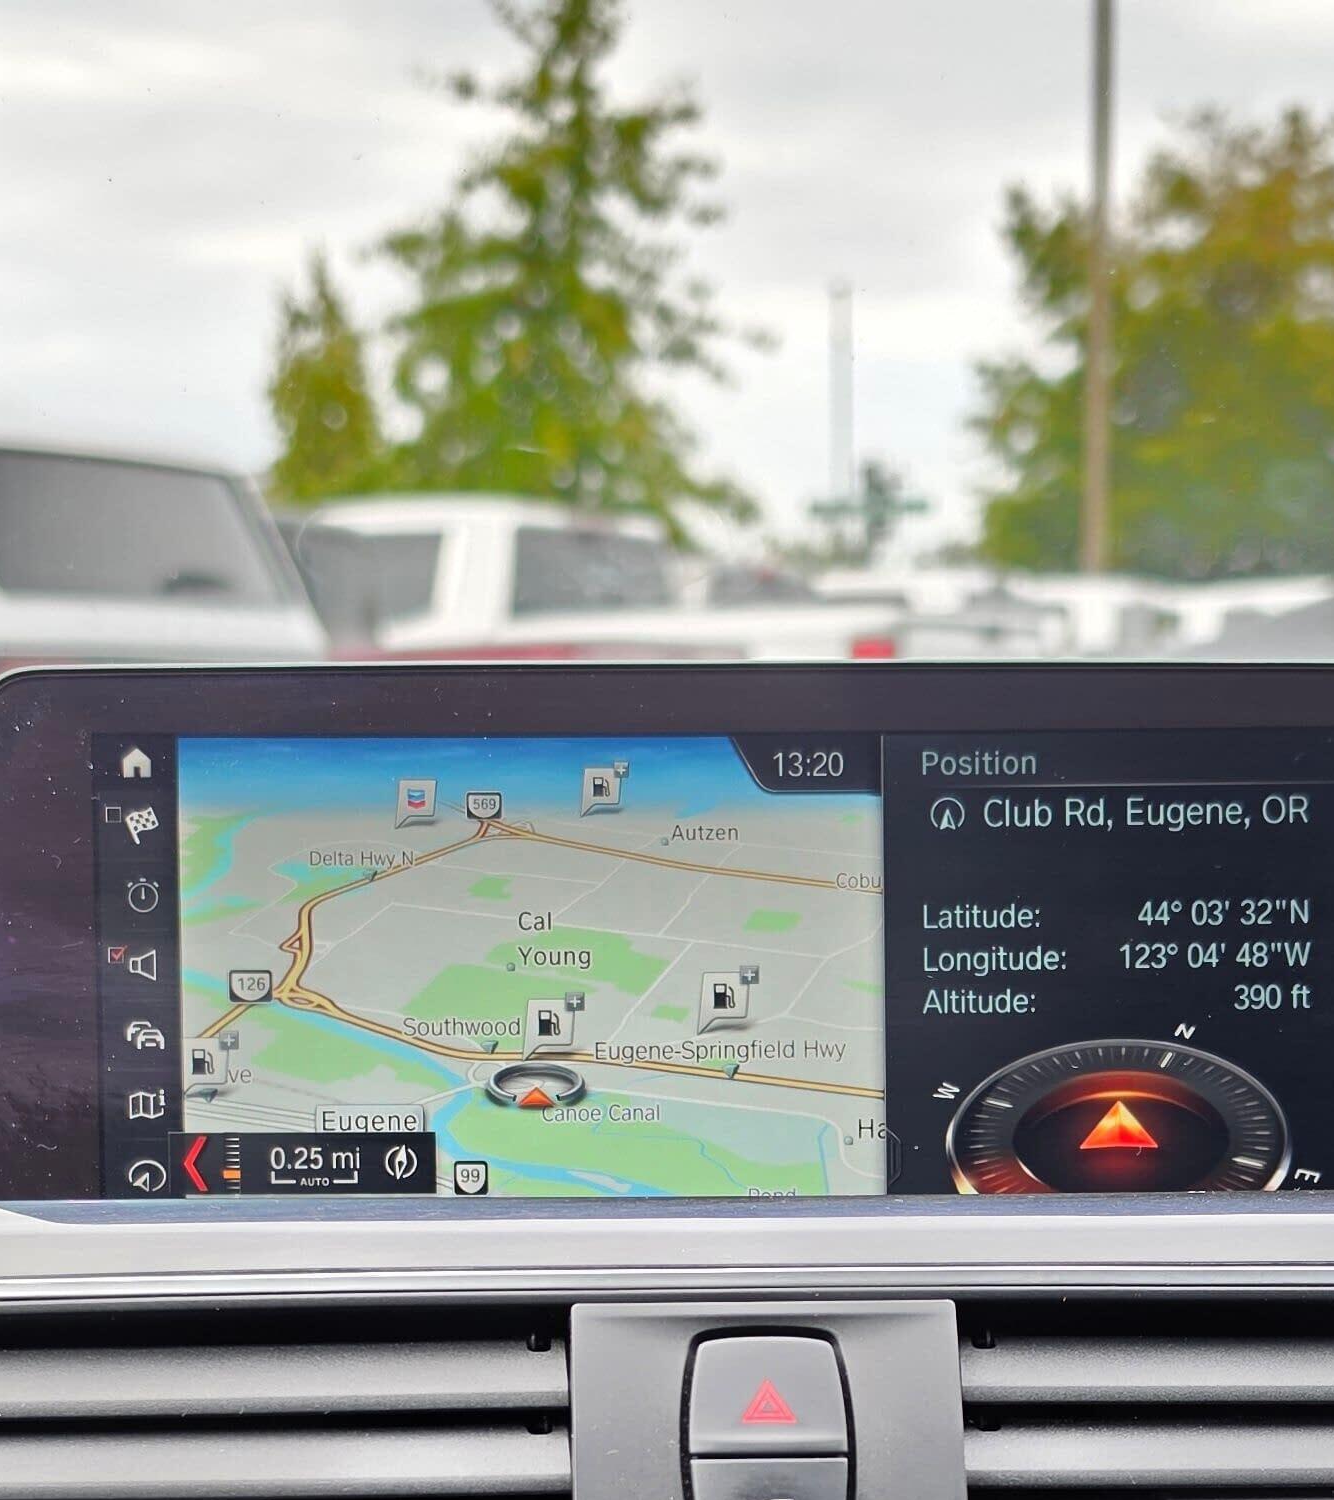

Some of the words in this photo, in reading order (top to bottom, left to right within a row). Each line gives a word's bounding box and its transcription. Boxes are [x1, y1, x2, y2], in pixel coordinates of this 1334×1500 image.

[772, 751, 845, 778] 13:20
[920, 750, 1037, 777] Position
[472, 797, 497, 811] 569
[983, 797, 1053, 830] Club
[1064, 796, 1113, 832] Rd,
[1125, 796, 1251, 832] Eugene,
[1262, 796, 1310, 824] OR
[671, 824, 739, 841] Autzen
[309, 850, 354, 867] Delta
[360, 850, 396, 870] Hwy
[401, 850, 415, 866] N
[518, 911, 552, 932] Cal
[921, 902, 1042, 929] Latitude:
[1136, 899, 1183, 926] 44°
[1190, 899, 1231, 926] 03'
[517, 945, 592, 971] Young
[921, 945, 1068, 978] Longitude:
[1118, 943, 1179, 970] 123°
[1186, 942, 1227, 970] 04'
[237, 977, 267, 992] 126
[921, 988, 1038, 1015] Altitude:
[1233, 985, 1282, 1011] 390
[1289, 983, 1311, 1011] ft
[402, 1017, 521, 1037] Southwood
[1174, 1022, 1196, 1040] N
[593, 1039, 796, 1063] Eugene-Springfield
[803, 1039, 846, 1062] Hwy
[321, 1110, 419, 1133] Eugene
[541, 1105, 602, 1122] Canoe
[608, 1103, 661, 1121] Canal
[269, 1147, 324, 1170] 0.25
[332, 1147, 361, 1169] mi
[299, 1177, 330, 1188] AUTO
[460, 1168, 481, 1184] 99
